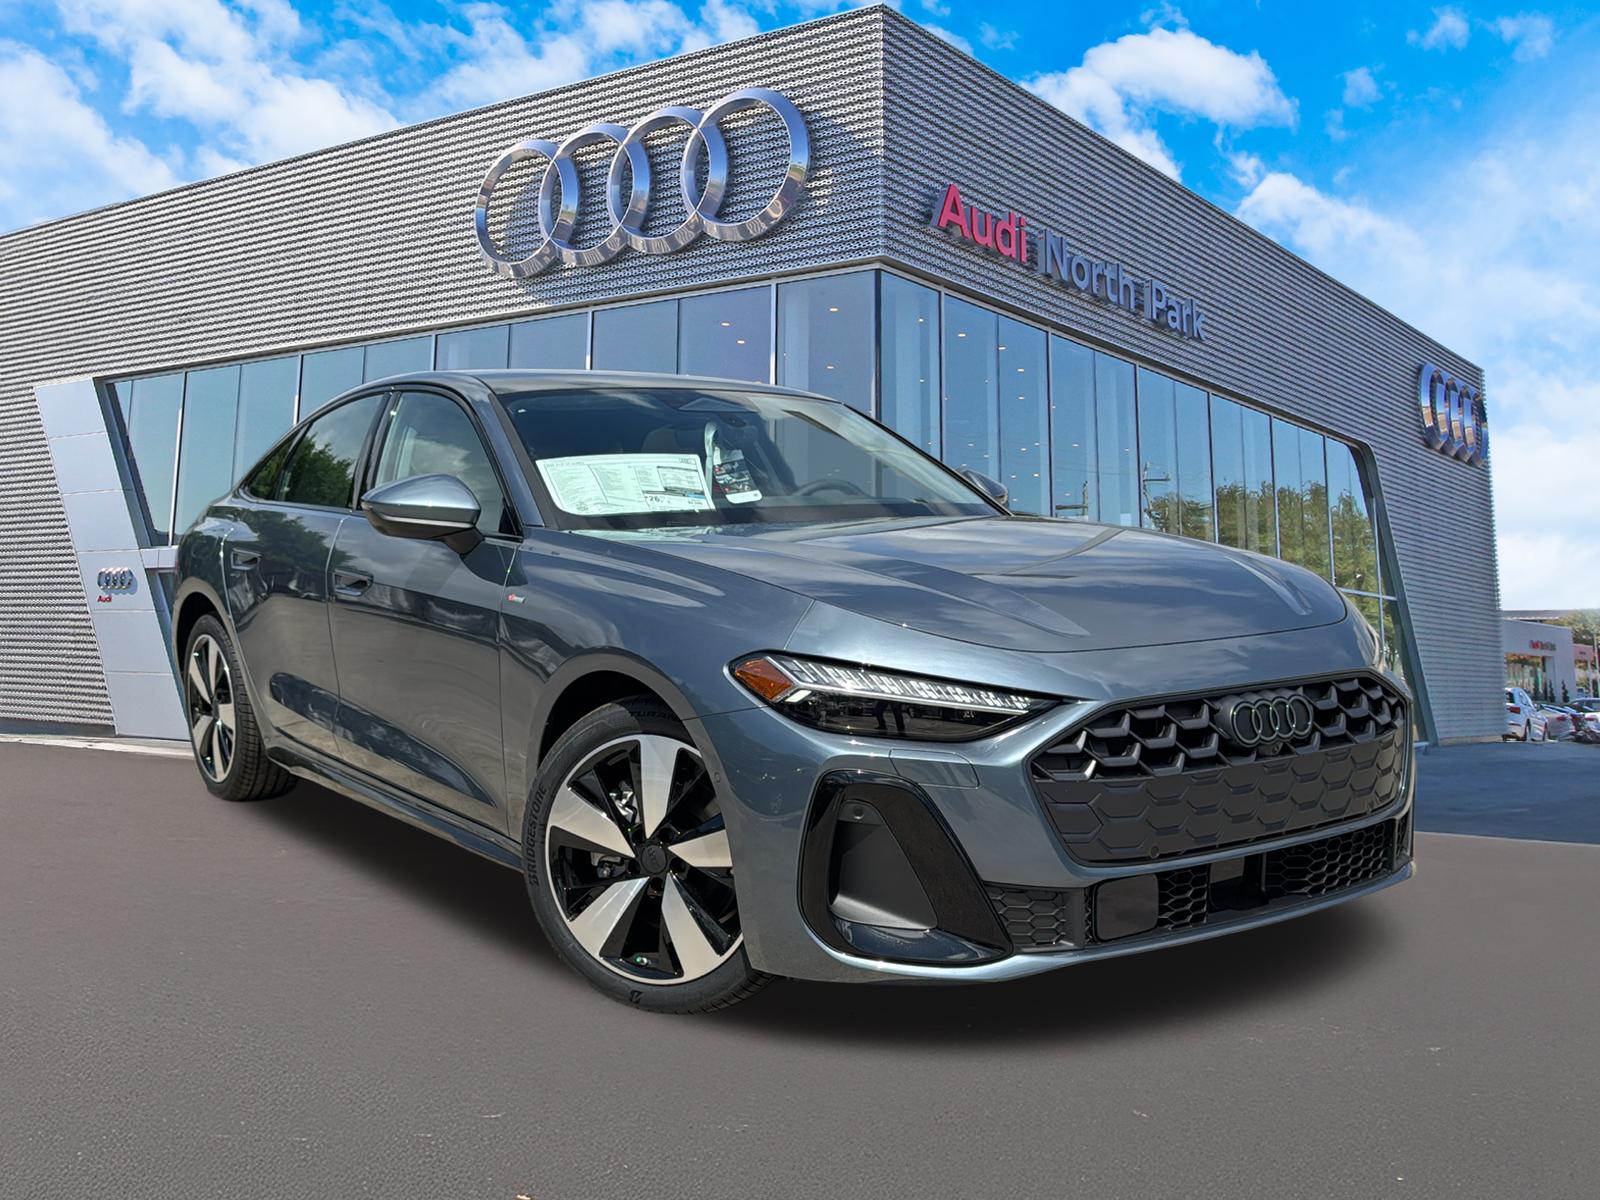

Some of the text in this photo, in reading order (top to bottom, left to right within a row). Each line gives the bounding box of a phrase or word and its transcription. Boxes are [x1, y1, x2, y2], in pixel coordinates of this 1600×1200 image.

[937, 183, 1207, 341] Audi North Park
[526, 783, 547, 886] BRIDGESTONE
